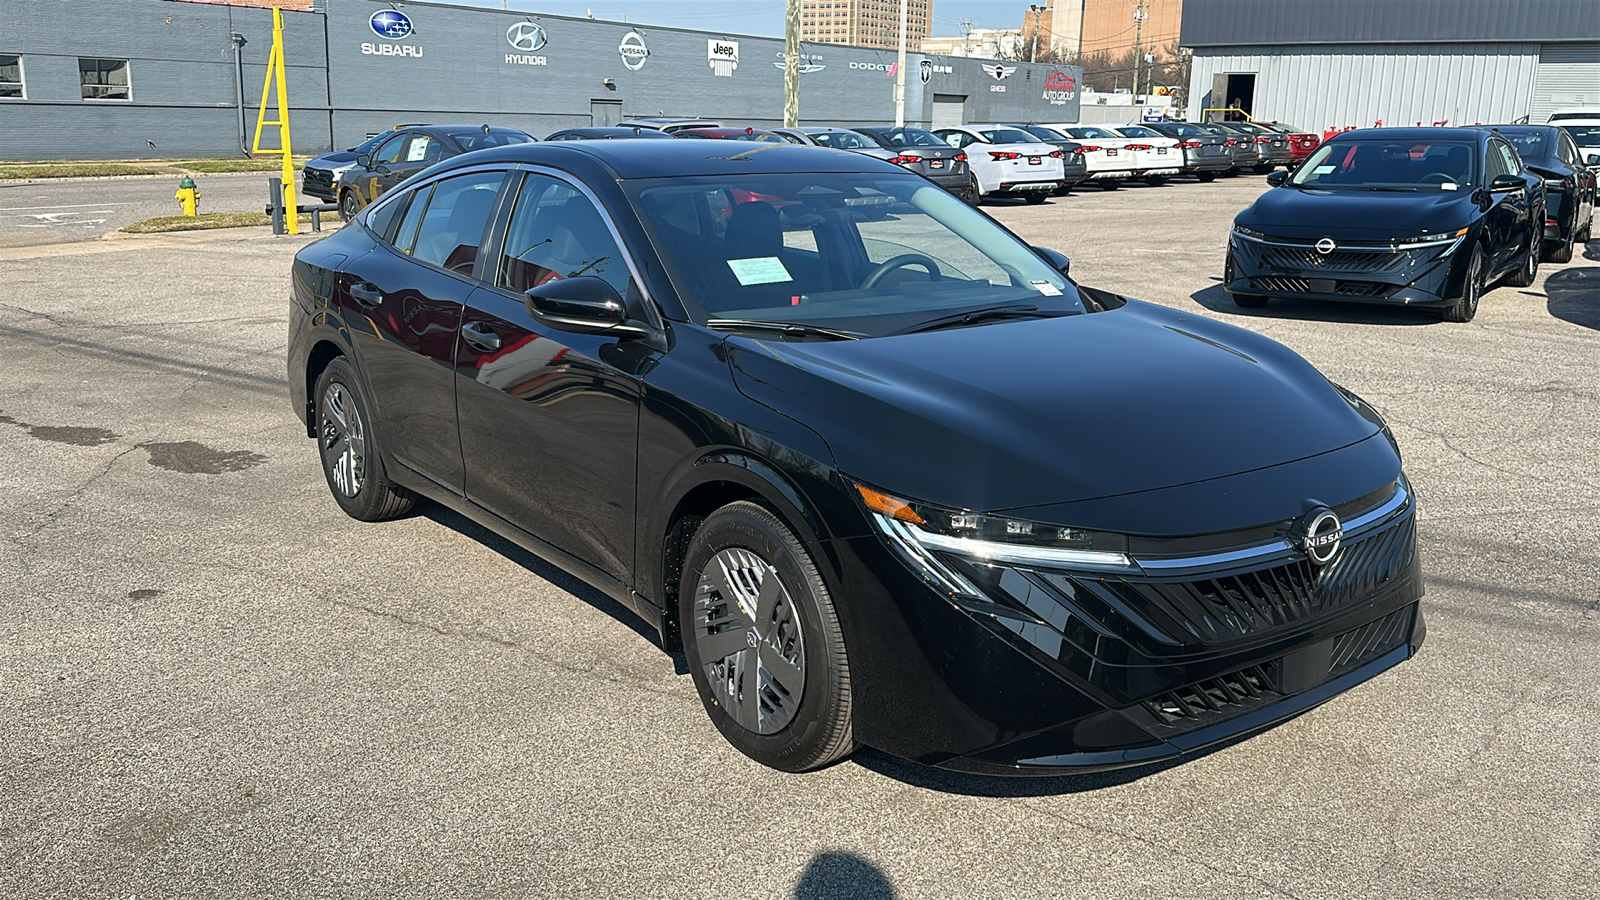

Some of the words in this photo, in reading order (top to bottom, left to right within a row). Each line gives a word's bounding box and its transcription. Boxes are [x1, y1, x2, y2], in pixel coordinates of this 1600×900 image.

[360, 42, 423, 58] SUBARU
[621, 47, 646, 56] NISSAN
[713, 42, 734, 57] Jeep
[504, 53, 547, 66] HYUNDAI
[849, 61, 893, 72] DODGE
[1042, 91, 1057, 100] AUTO
[1057, 91, 1075, 101] GROUP
[1306, 529, 1344, 548] NISSAN
